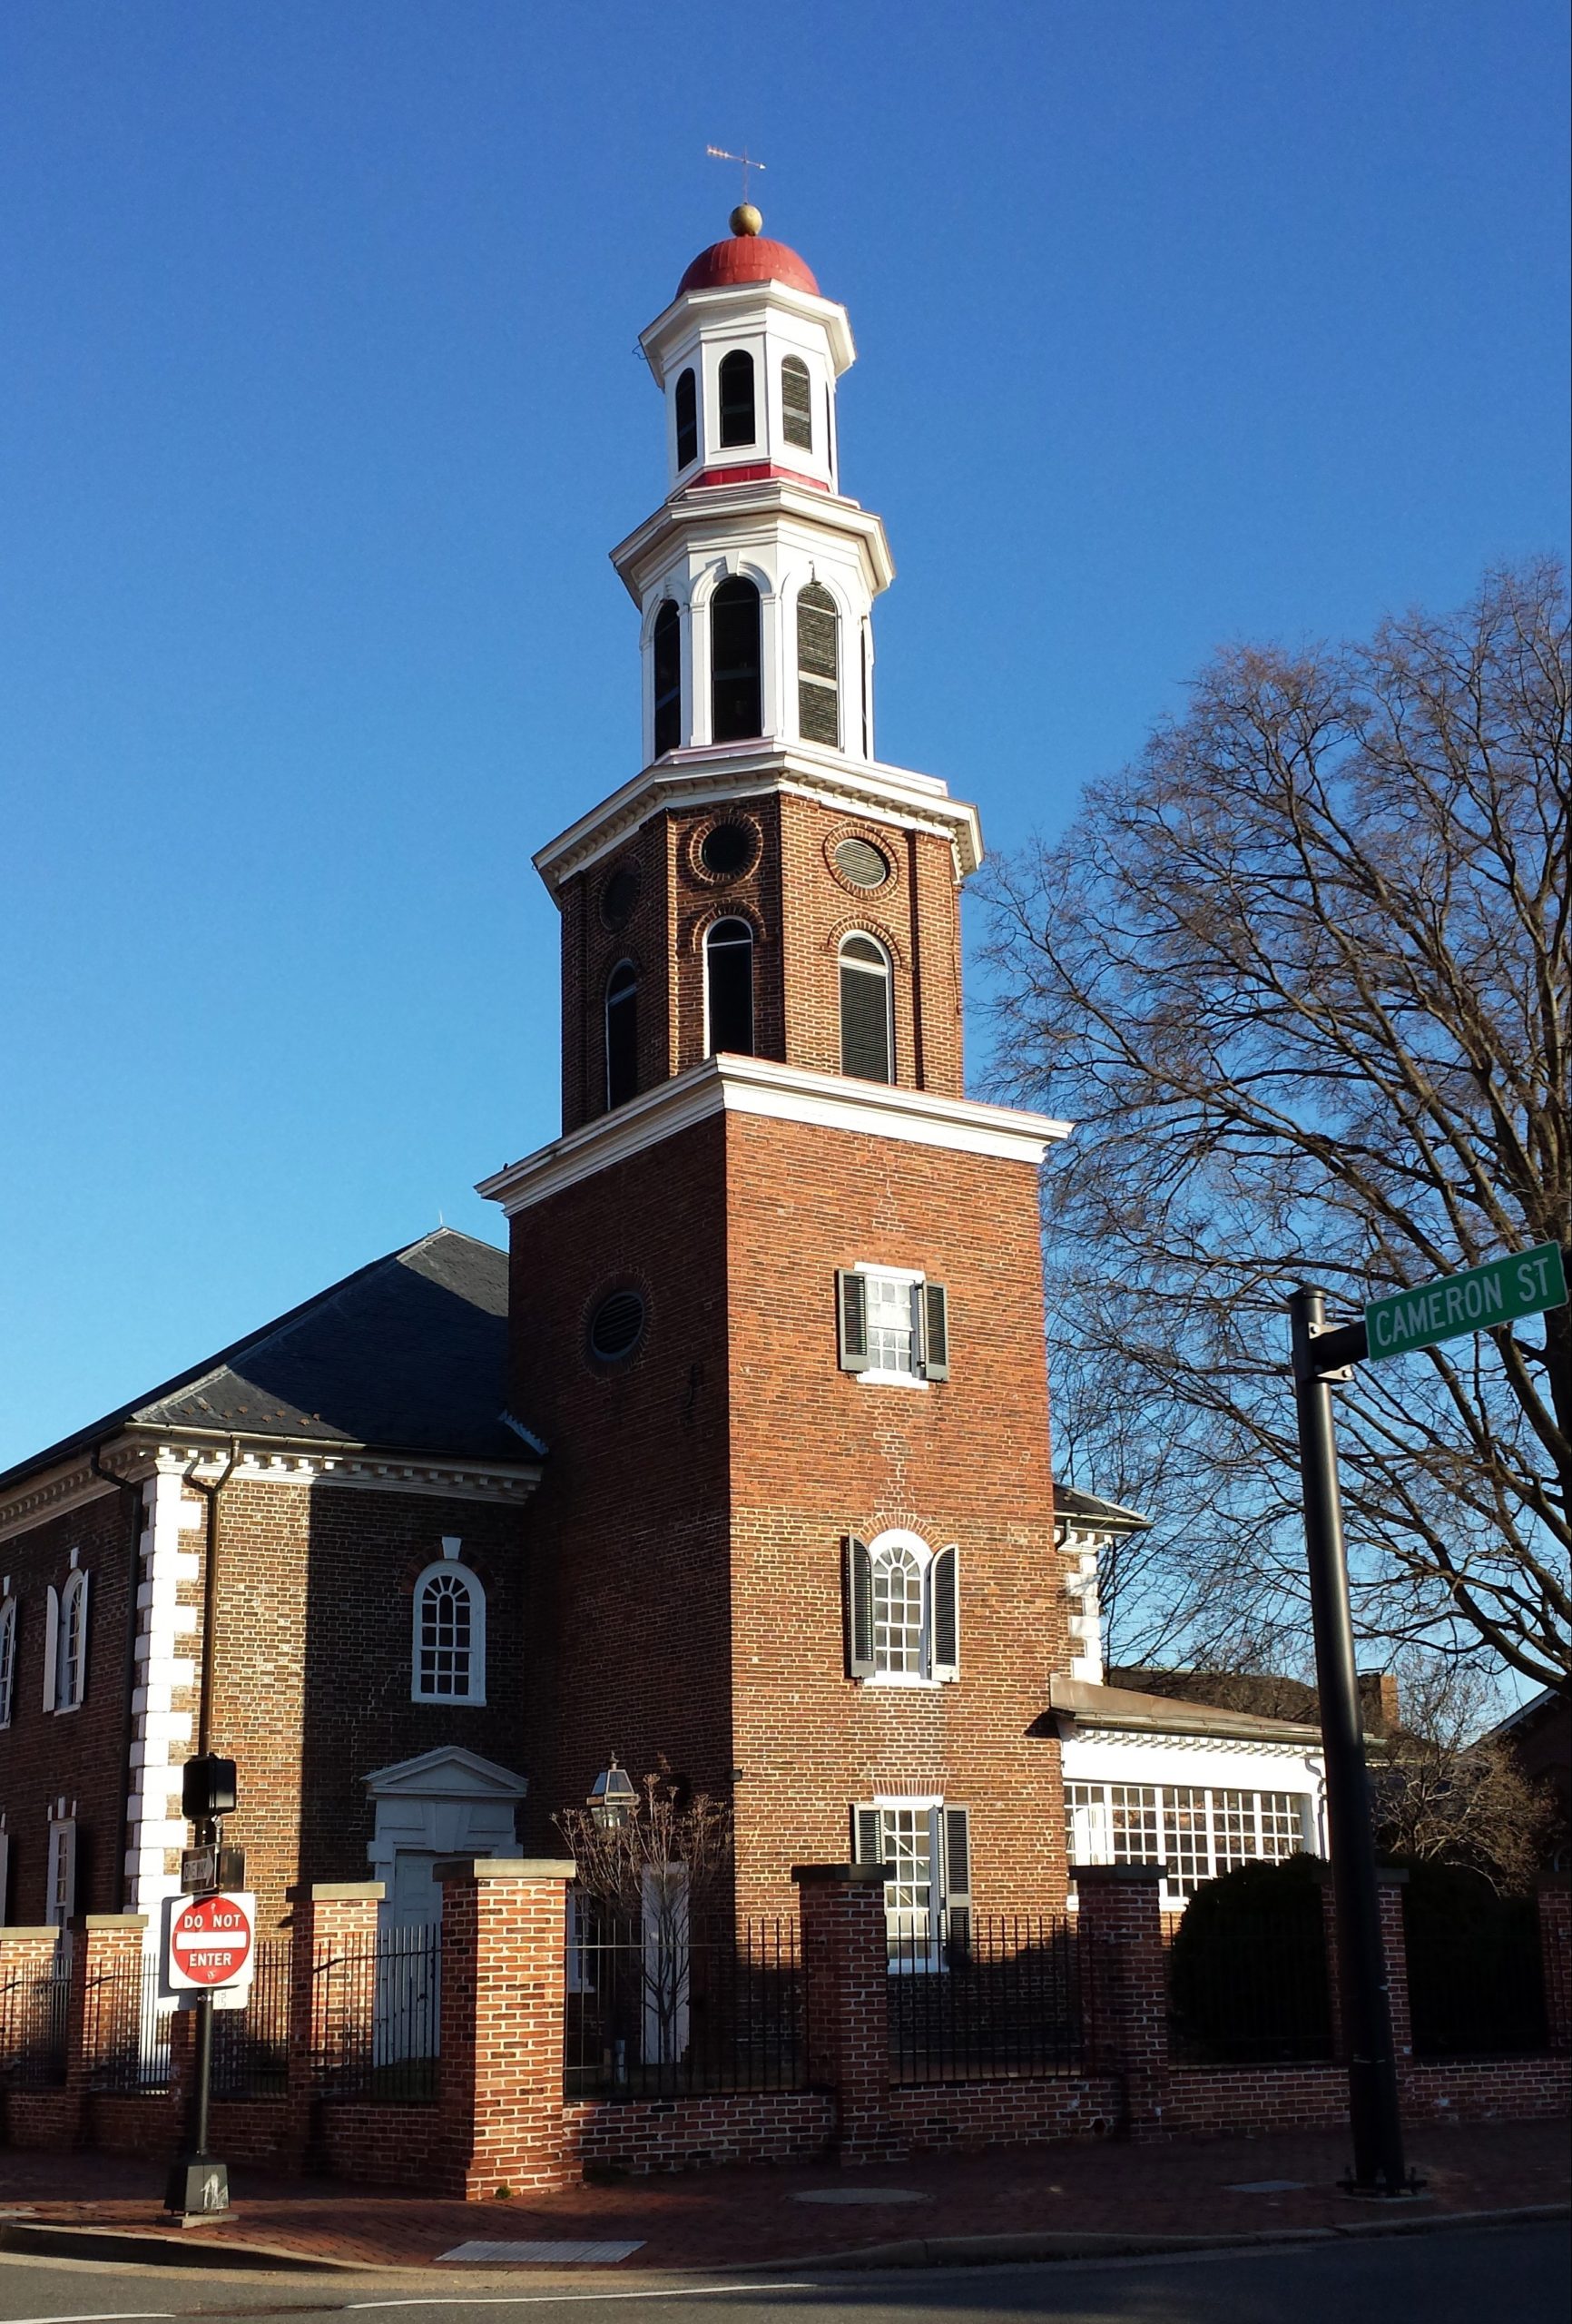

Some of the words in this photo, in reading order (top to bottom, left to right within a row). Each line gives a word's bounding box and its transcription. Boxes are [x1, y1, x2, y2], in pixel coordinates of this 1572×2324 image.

[1376, 1274, 1502, 1346] CAMERON
[1518, 1257, 1548, 1302] ST
[184, 1915, 203, 1928] DO
[213, 1915, 241, 1927] NOT
[189, 1953, 232, 1967] ENTER
